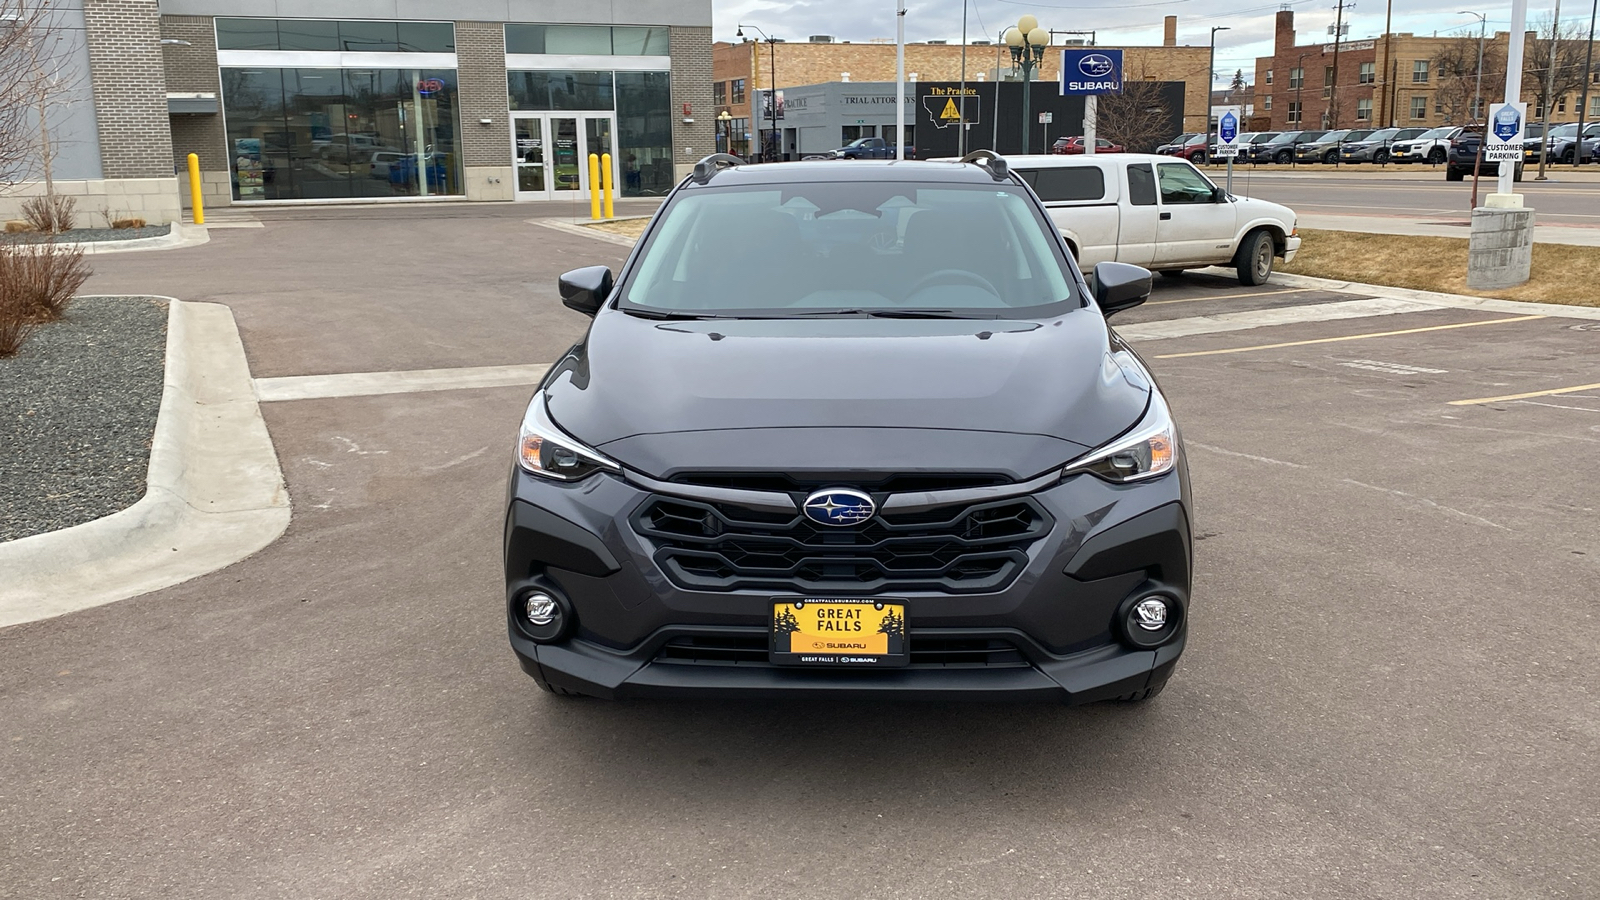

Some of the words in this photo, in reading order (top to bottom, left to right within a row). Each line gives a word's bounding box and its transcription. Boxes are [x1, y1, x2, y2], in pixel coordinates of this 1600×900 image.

[416, 79, 442, 91] OPEN
[1069, 81, 1119, 90] SUBARU
[930, 87, 946, 95] The
[844, 96, 869, 104] TRIAL
[870, 96, 916, 104] ATTORYS
[1489, 152, 1519, 160] PARKING
[817, 608, 862, 619] GREAT
[817, 620, 862, 632] FALLS
